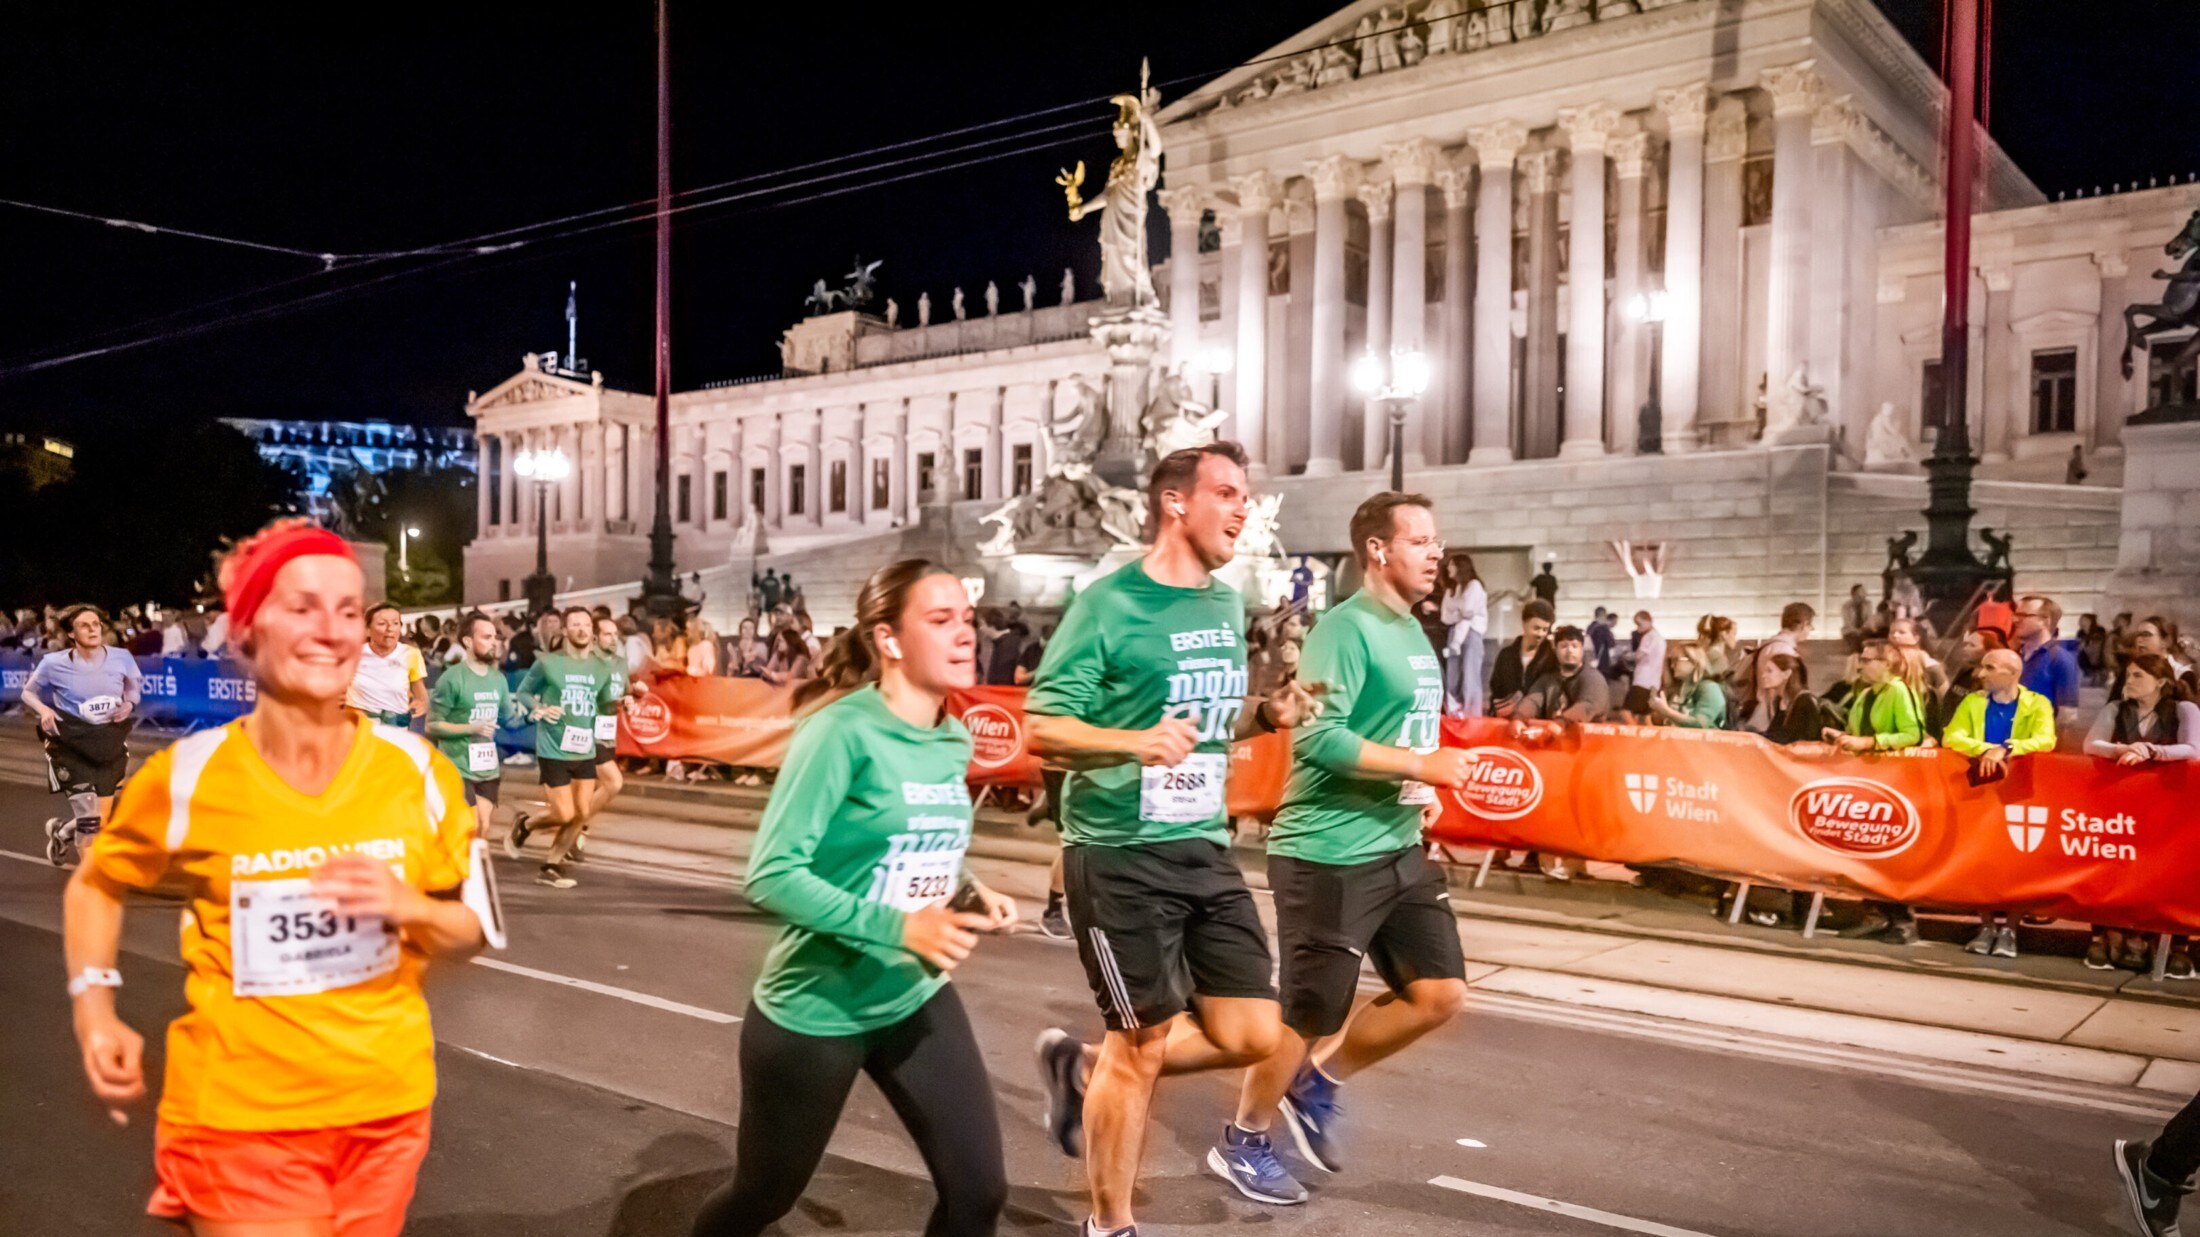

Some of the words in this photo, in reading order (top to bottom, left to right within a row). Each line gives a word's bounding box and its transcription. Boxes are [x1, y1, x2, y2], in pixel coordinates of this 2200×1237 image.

[1170, 629, 1220, 651] ERSTE
[208, 677, 243, 701] ERSTE
[89, 702, 111, 712] 3877
[967, 716, 1010, 737] Wien
[1904, 747, 1938, 758] Wien
[1163, 772, 1206, 790] 2688
[1666, 776, 1719, 800] Stadt
[1665, 799, 1719, 822] Wien
[1807, 792, 1893, 821] Wien
[1814, 816, 1903, 836] Bewegung
[2060, 808, 2136, 835] Stadt
[1842, 830, 1889, 845] Stadt
[2060, 834, 2137, 861] Wien
[231, 845, 327, 875] RADIO
